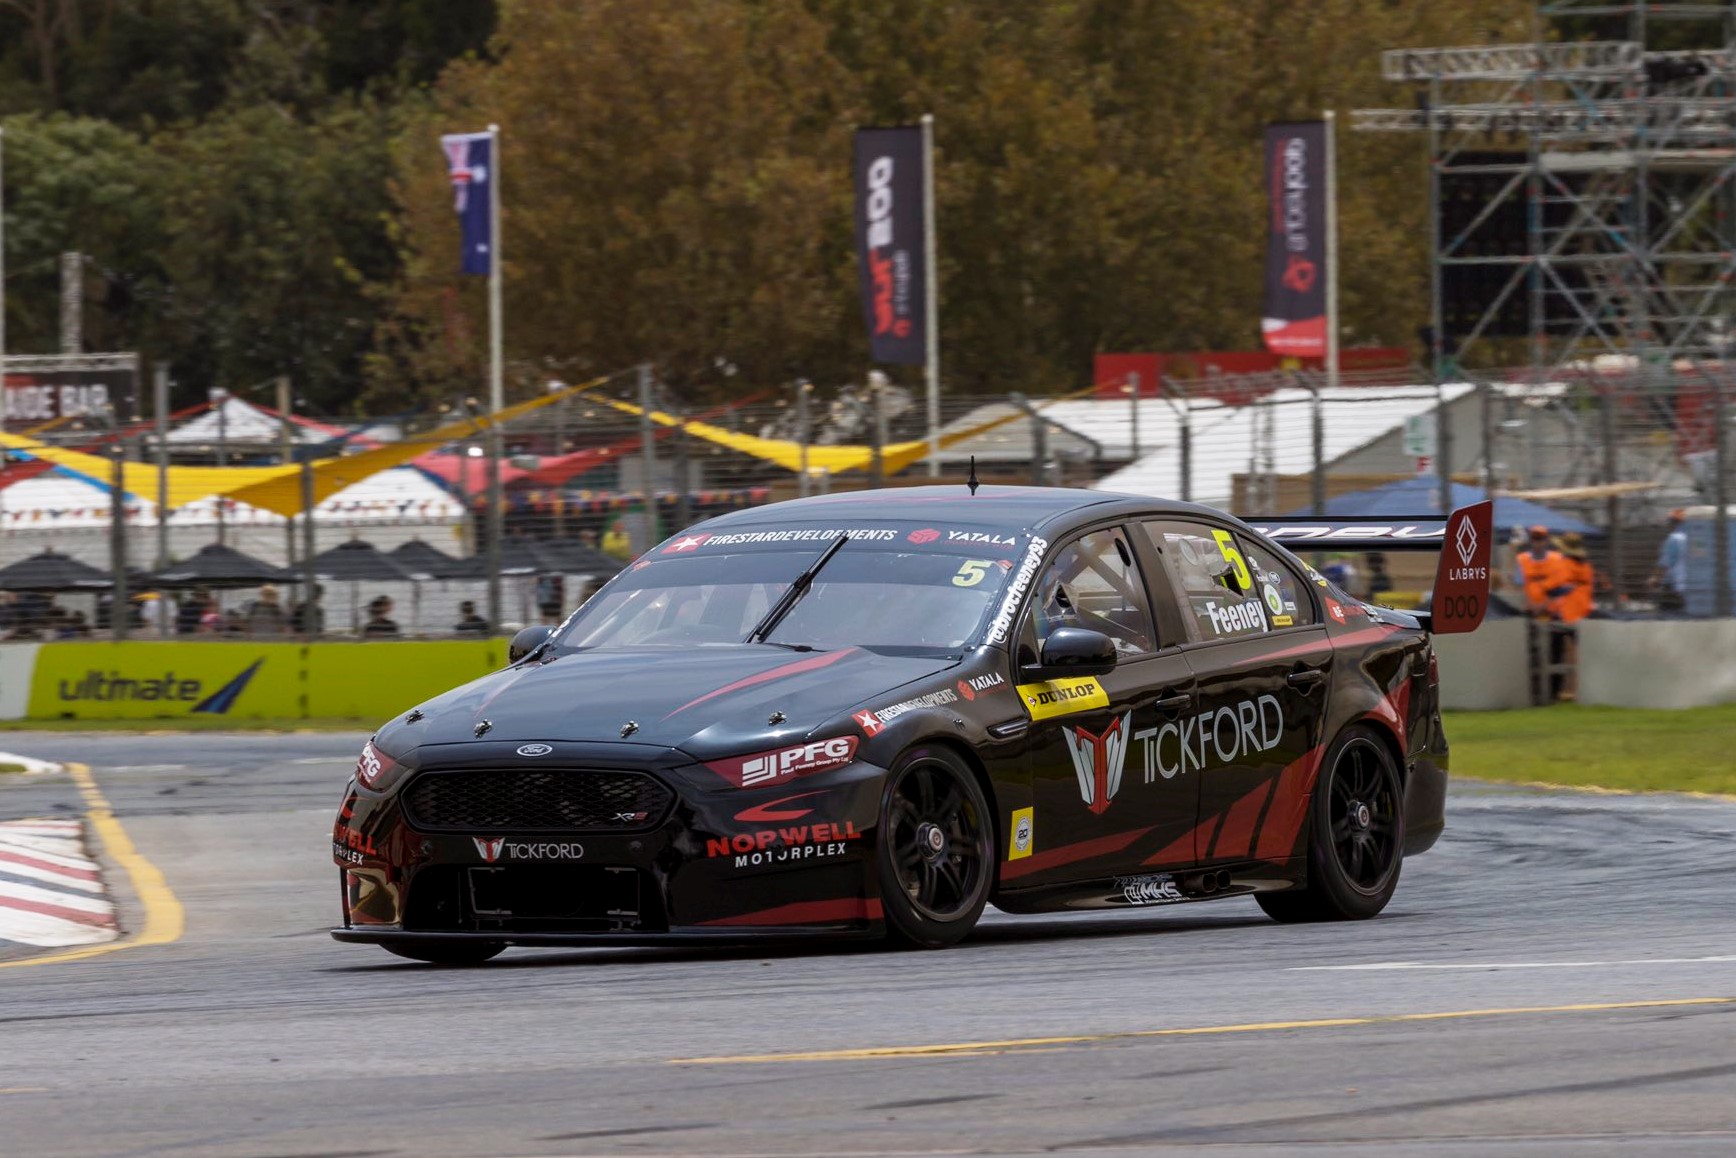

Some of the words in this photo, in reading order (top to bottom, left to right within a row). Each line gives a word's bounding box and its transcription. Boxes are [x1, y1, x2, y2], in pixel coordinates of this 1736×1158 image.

[948, 531, 1016, 546] YATALA
[952, 560, 993, 587] 5
[1211, 529, 1251, 590] 5
[1449, 567, 1486, 581] LABRYS
[988, 536, 1048, 643] @brocfeeney93
[1206, 600, 1268, 635] Feeney
[59, 670, 202, 702] ultimate
[968, 672, 1005, 691] YATALA
[1037, 683, 1096, 705] DUNLOP
[780, 739, 849, 768] PFG
